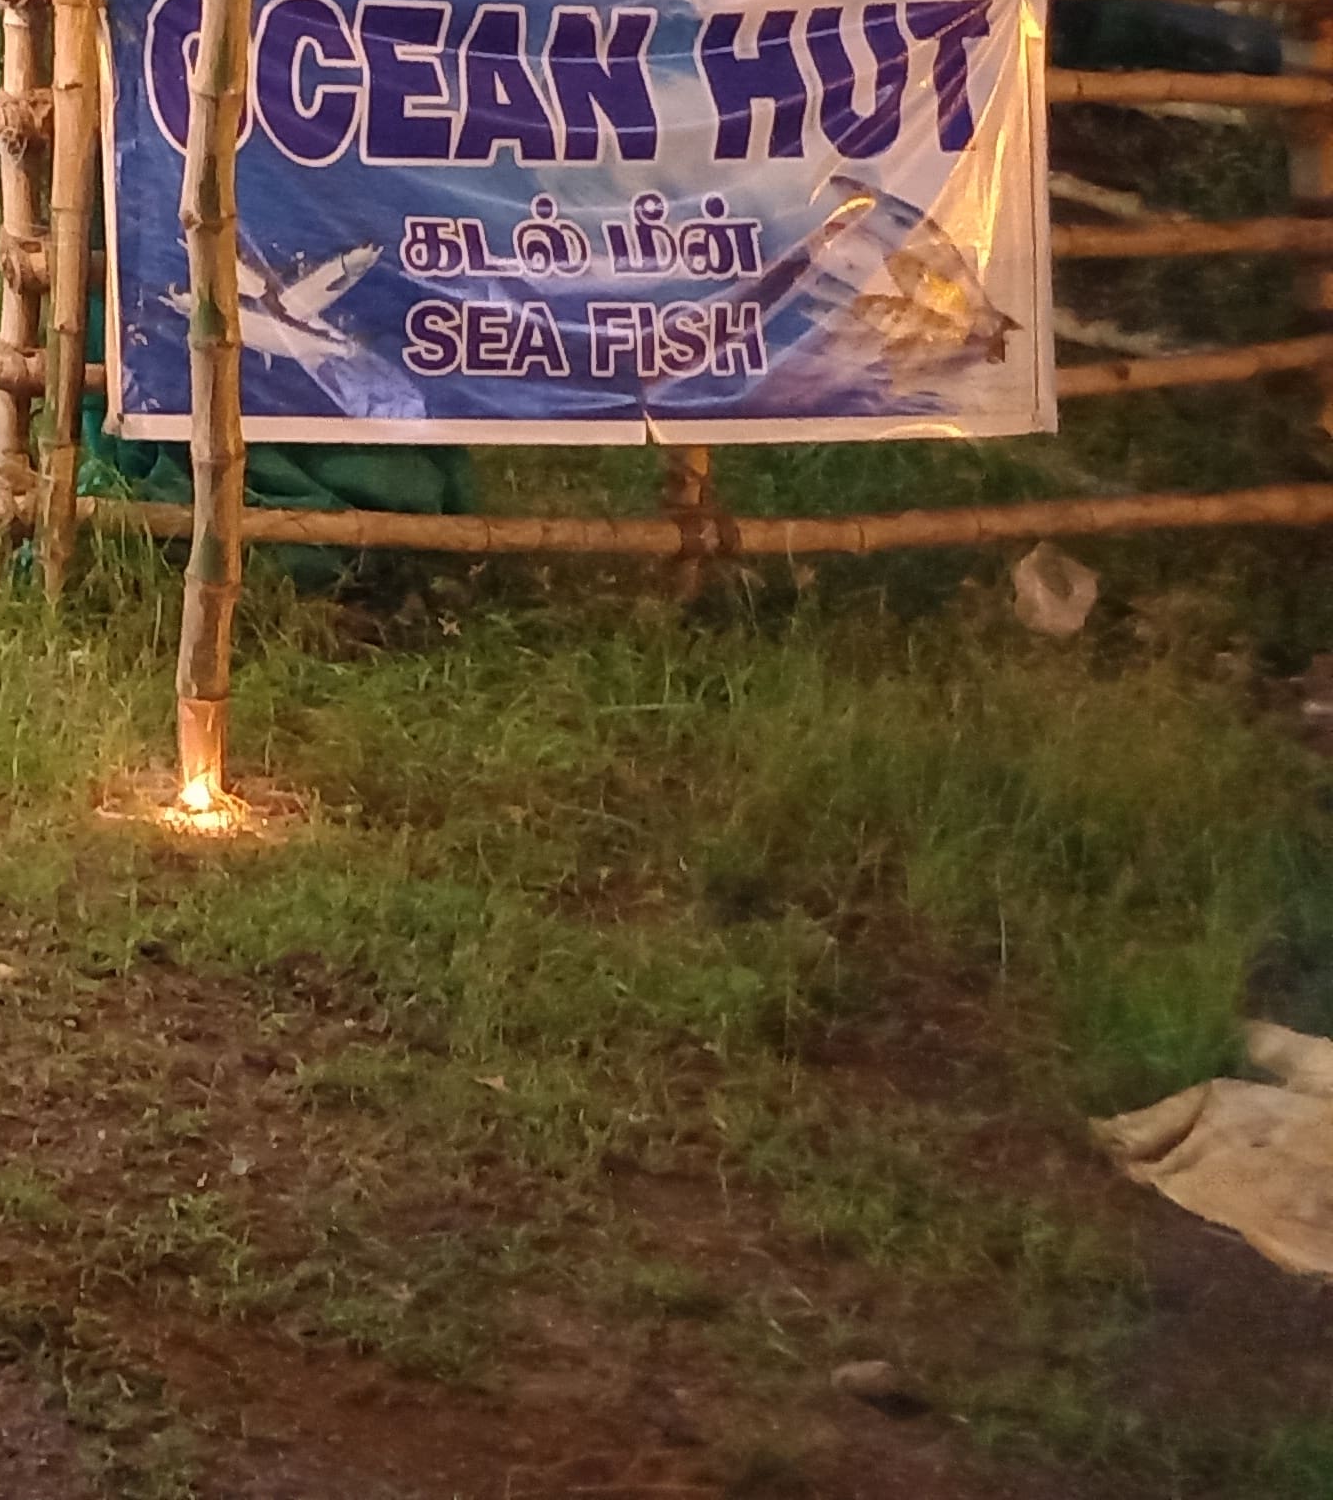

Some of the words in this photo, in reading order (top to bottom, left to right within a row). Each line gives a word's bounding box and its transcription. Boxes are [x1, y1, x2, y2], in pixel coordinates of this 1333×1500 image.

[399, 192, 592, 278] கடல்
[602, 189, 762, 281] மீன்
[402, 300, 571, 377] SEA
[587, 301, 768, 378] FISH
